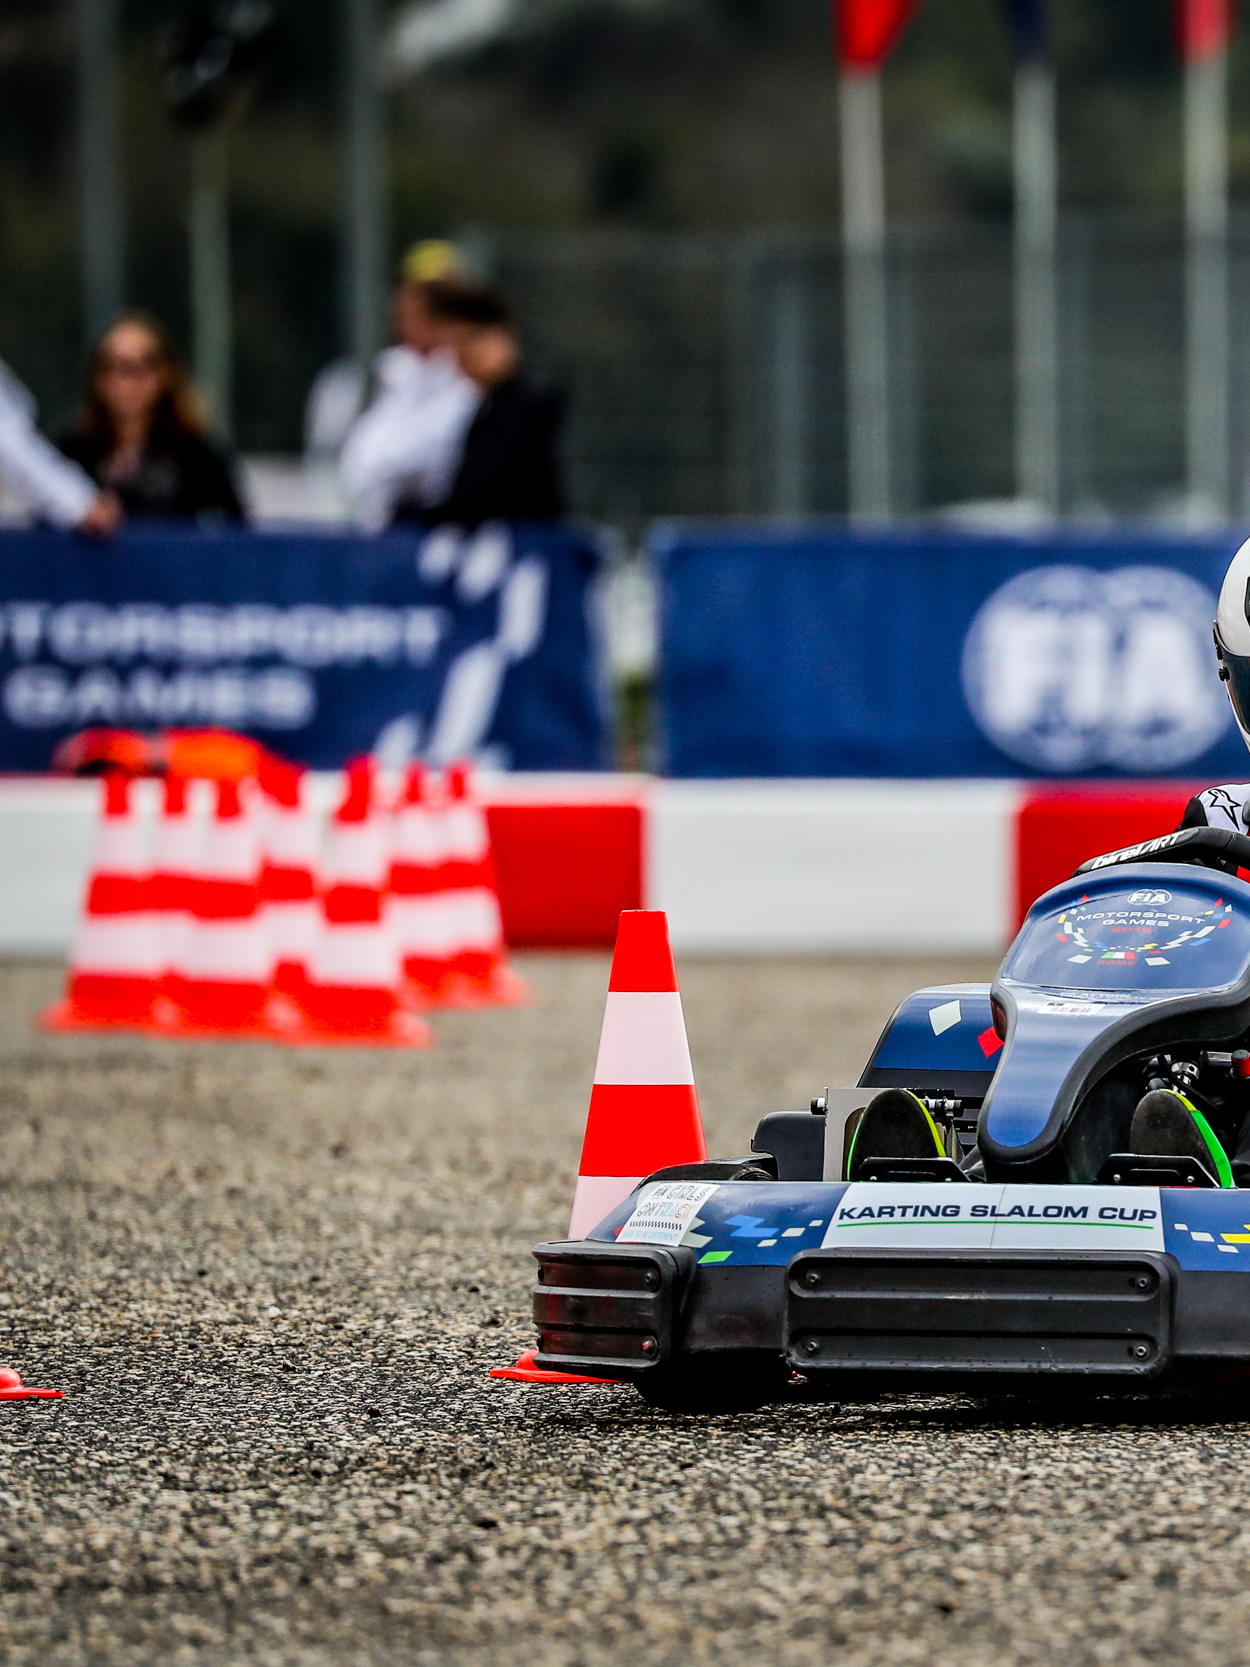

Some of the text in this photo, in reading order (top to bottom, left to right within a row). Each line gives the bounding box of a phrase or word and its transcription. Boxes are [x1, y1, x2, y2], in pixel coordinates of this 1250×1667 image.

[0, 602, 450, 666] TORSPORT
[981, 603, 1214, 735] FIA
[4, 664, 315, 731] GAMES
[1076, 911, 1205, 924] MOTORSPORT
[1102, 919, 1169, 927] GAMES
[666, 1185, 711, 1202] GIRLS
[838, 1205, 1157, 1221] KARTING SLALOM CUP
